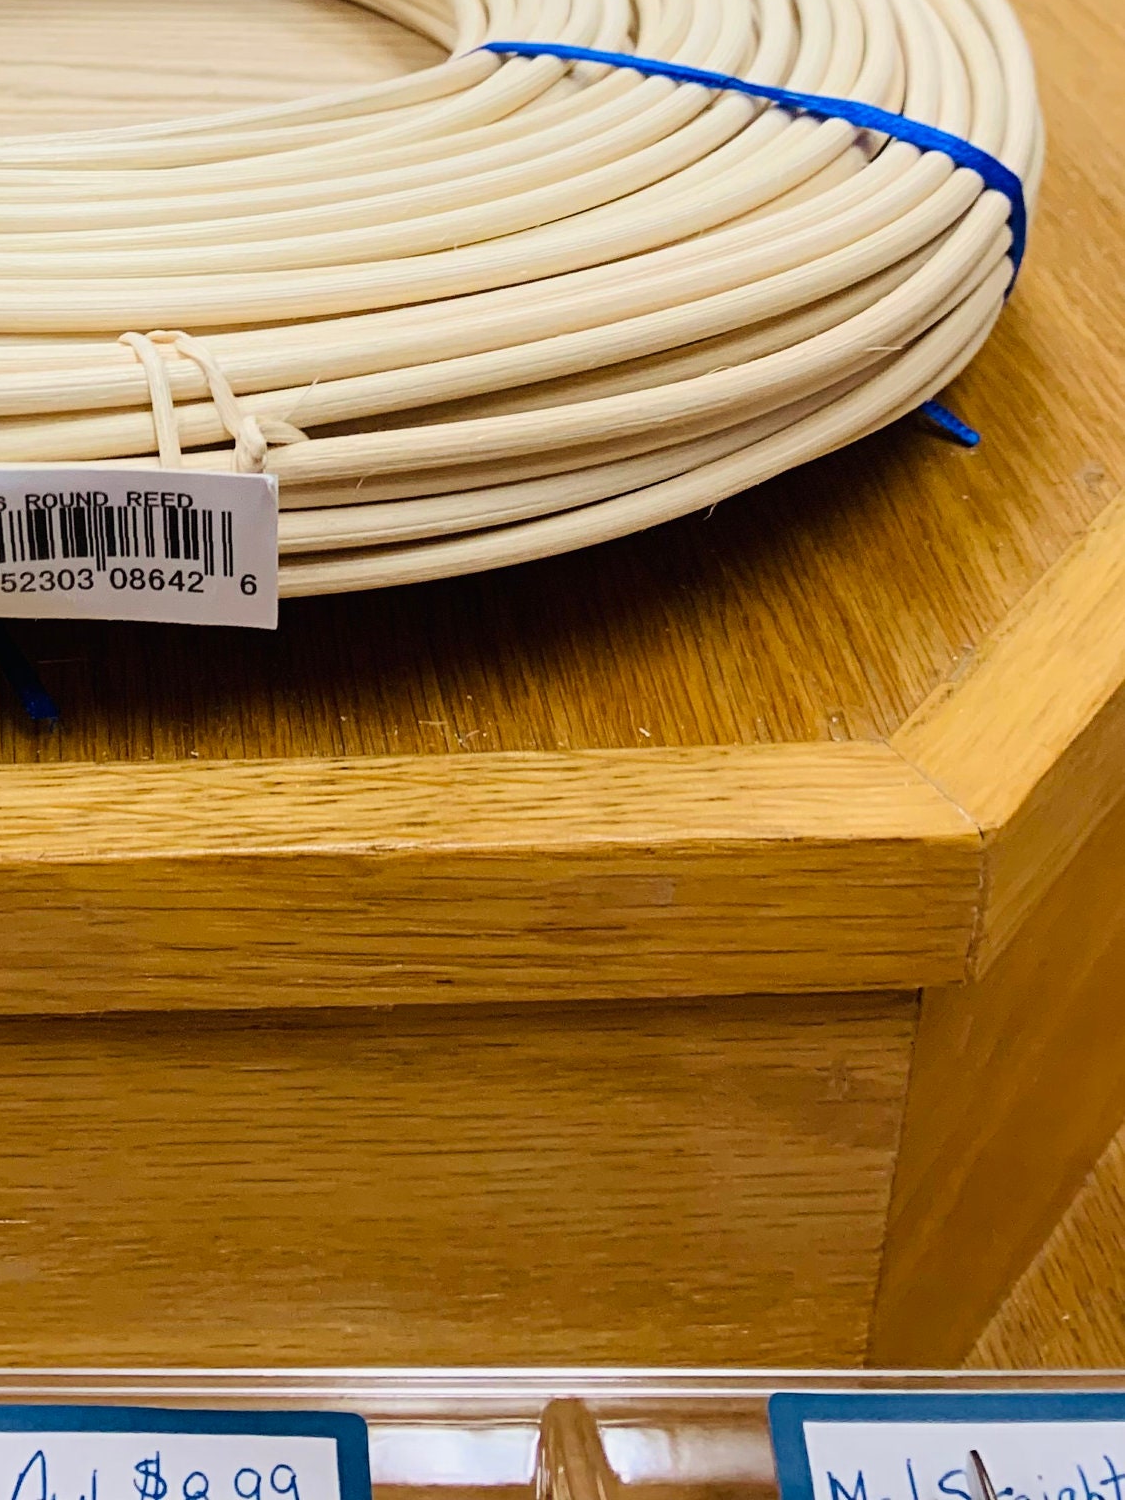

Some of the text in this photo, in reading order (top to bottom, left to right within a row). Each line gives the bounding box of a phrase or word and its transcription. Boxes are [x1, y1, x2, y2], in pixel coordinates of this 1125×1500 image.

[25, 491, 109, 510] ROUND
[127, 491, 194, 509] REED
[0, 567, 258, 596] 52303 08642 6
